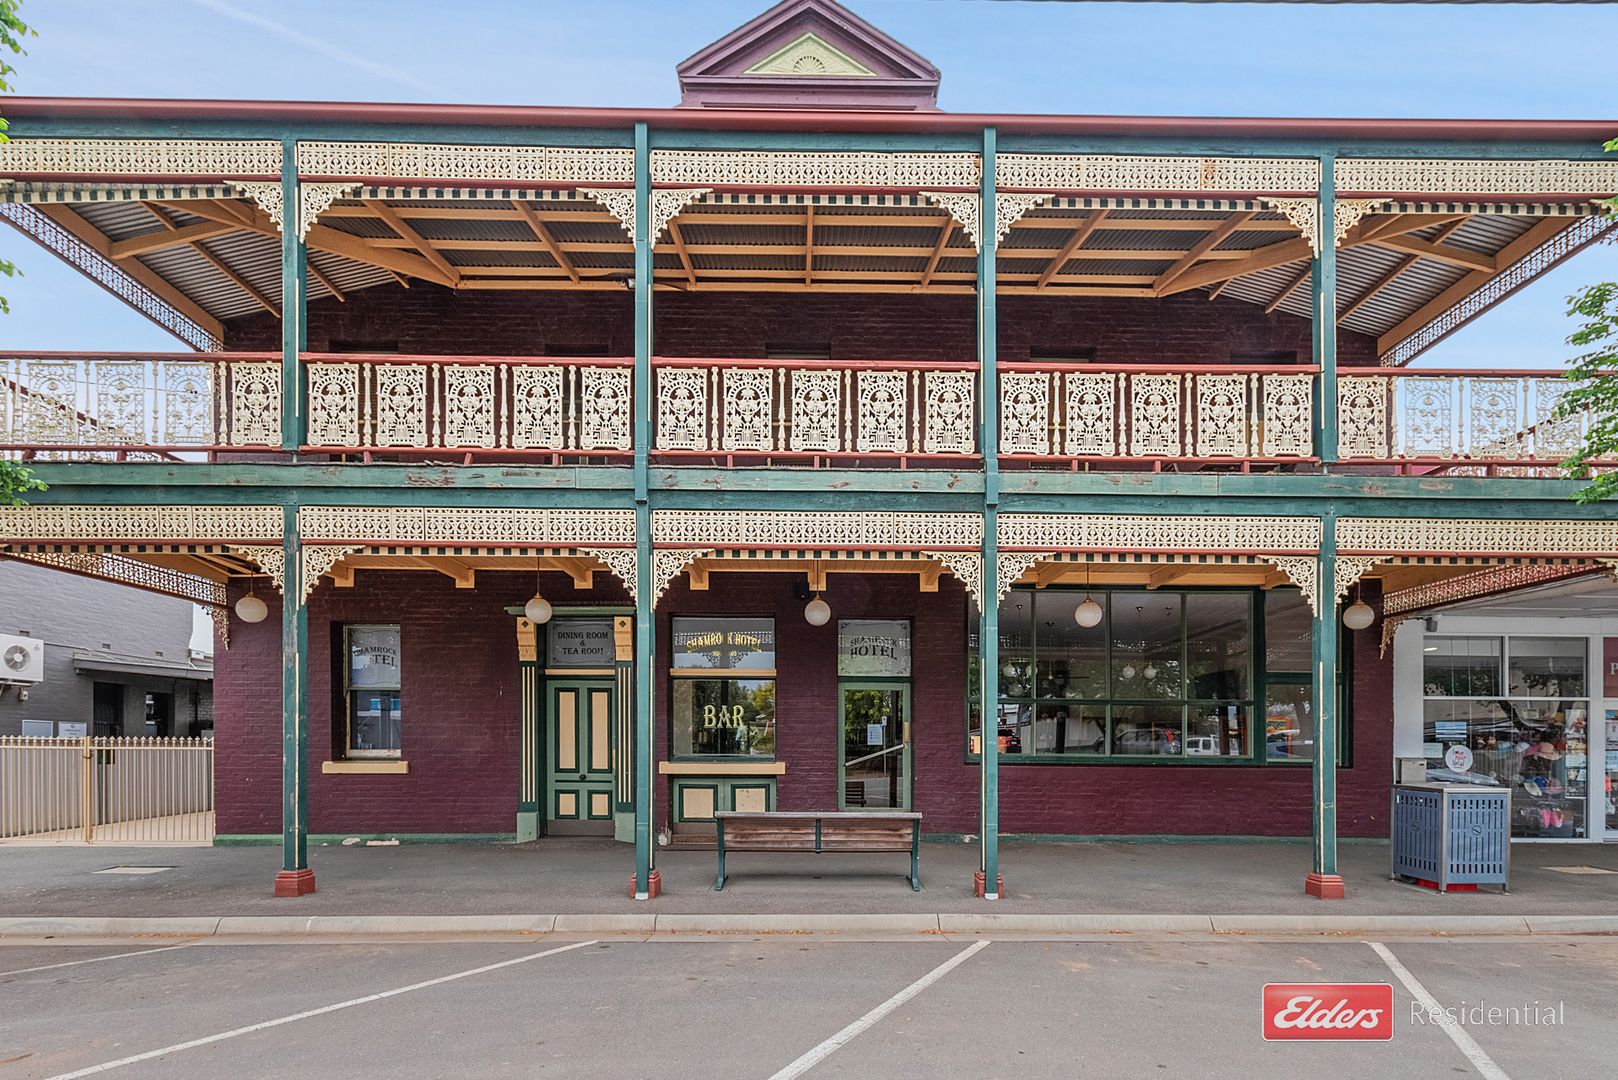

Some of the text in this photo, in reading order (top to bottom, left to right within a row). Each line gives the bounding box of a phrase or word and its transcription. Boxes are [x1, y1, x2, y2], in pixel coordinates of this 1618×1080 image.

[557, 631, 609, 639] DINING ROOM
[735, 633, 762, 653] HOTEL
[561, 647, 604, 655] TEA ROOM
[850, 645, 898, 660] HOTEL
[703, 704, 746, 729] BAR
